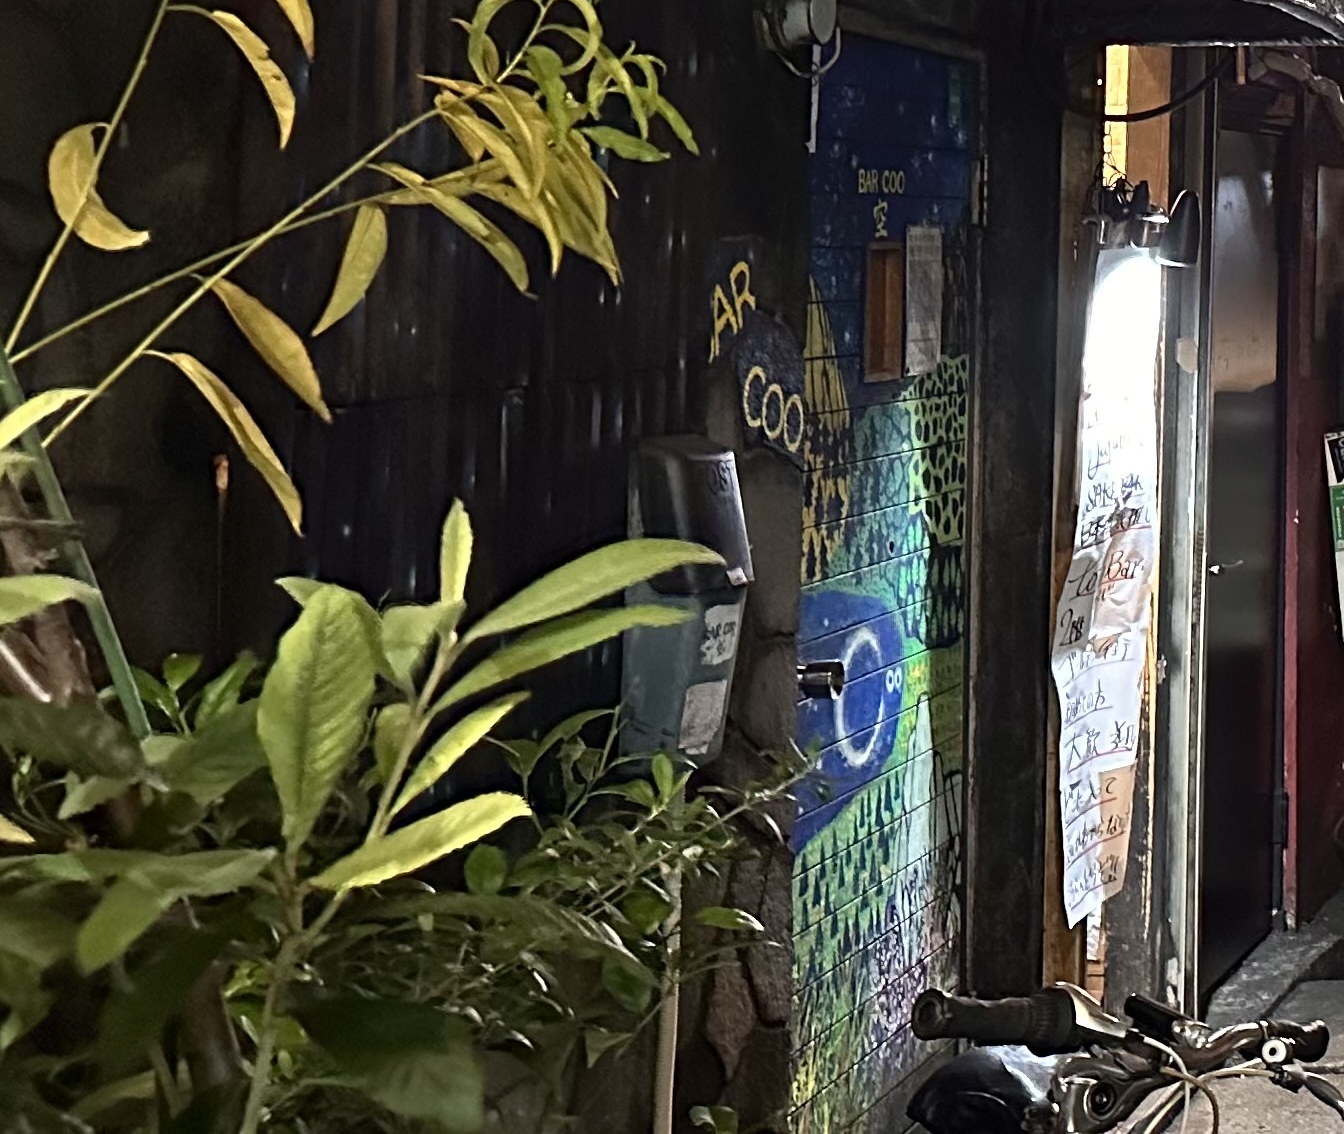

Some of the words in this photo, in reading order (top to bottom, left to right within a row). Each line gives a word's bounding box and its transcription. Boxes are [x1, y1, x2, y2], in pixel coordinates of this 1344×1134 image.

[858, 169, 879, 194] BAR
[882, 169, 905, 194] COO
[743, 366, 804, 453] COO
